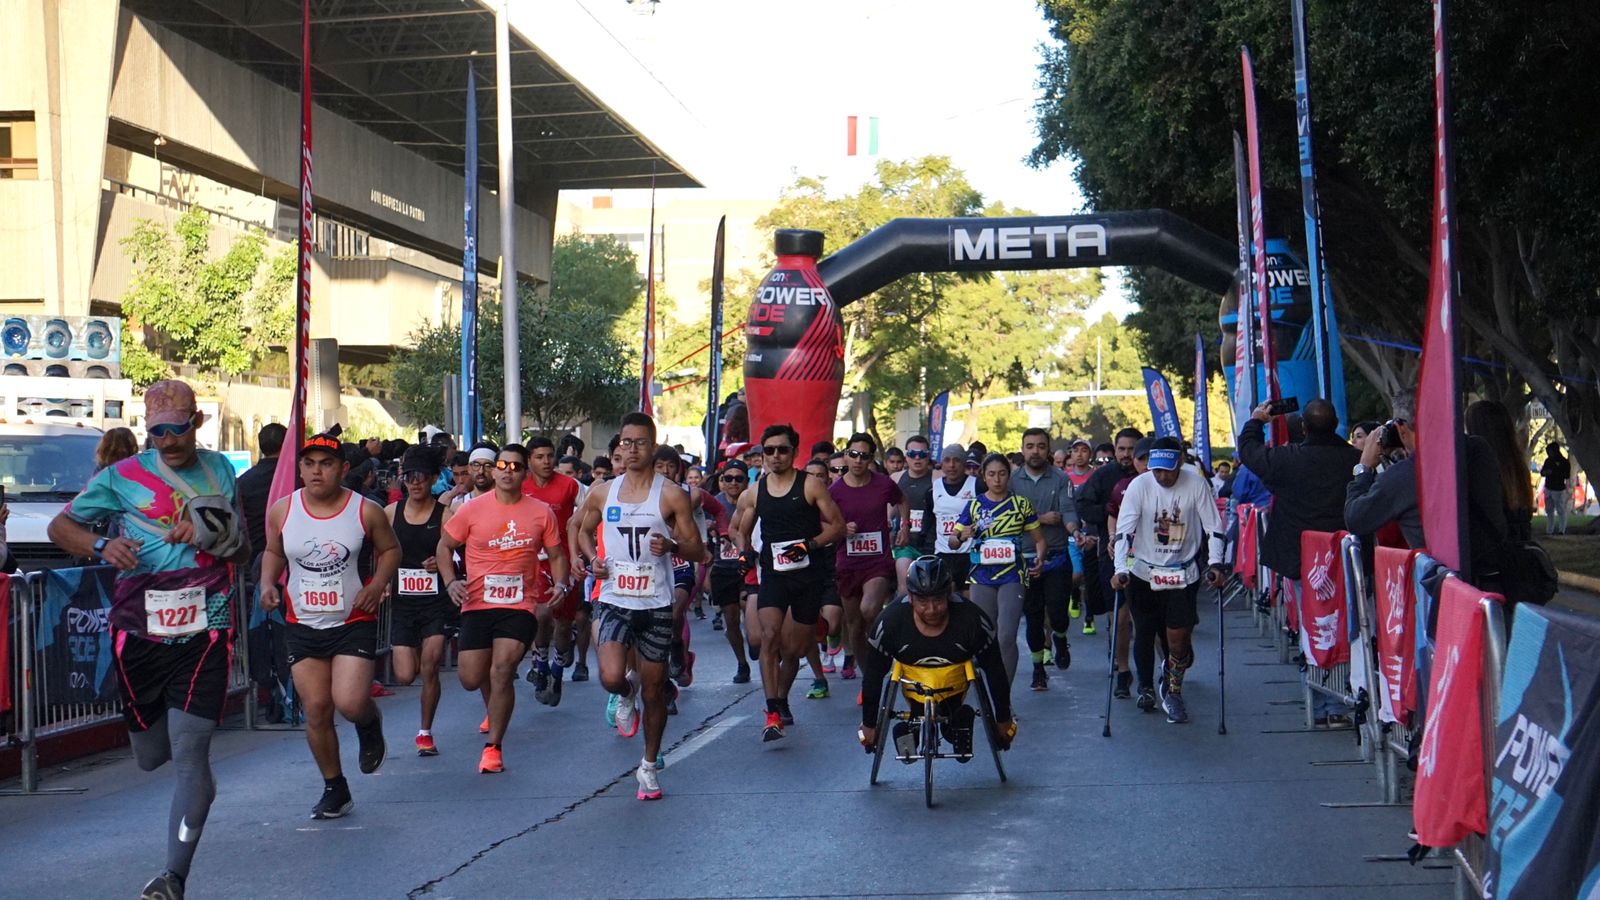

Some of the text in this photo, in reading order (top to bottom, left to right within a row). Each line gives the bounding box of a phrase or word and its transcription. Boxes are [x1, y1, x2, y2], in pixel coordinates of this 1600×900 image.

[954, 224, 1107, 261] META
[488, 535, 514, 548] RUN
[499, 538, 533, 550] SPOT
[850, 539, 878, 552] 1445
[983, 547, 1012, 559] 0438
[315, 556, 342, 567] ANGELES
[402, 577, 433, 591] 1002
[617, 574, 650, 591] 0977
[1154, 575, 1182, 586] 0437
[303, 590, 338, 606] 1690
[489, 585, 519, 599] 2847
[155, 604, 198, 628] 1227
